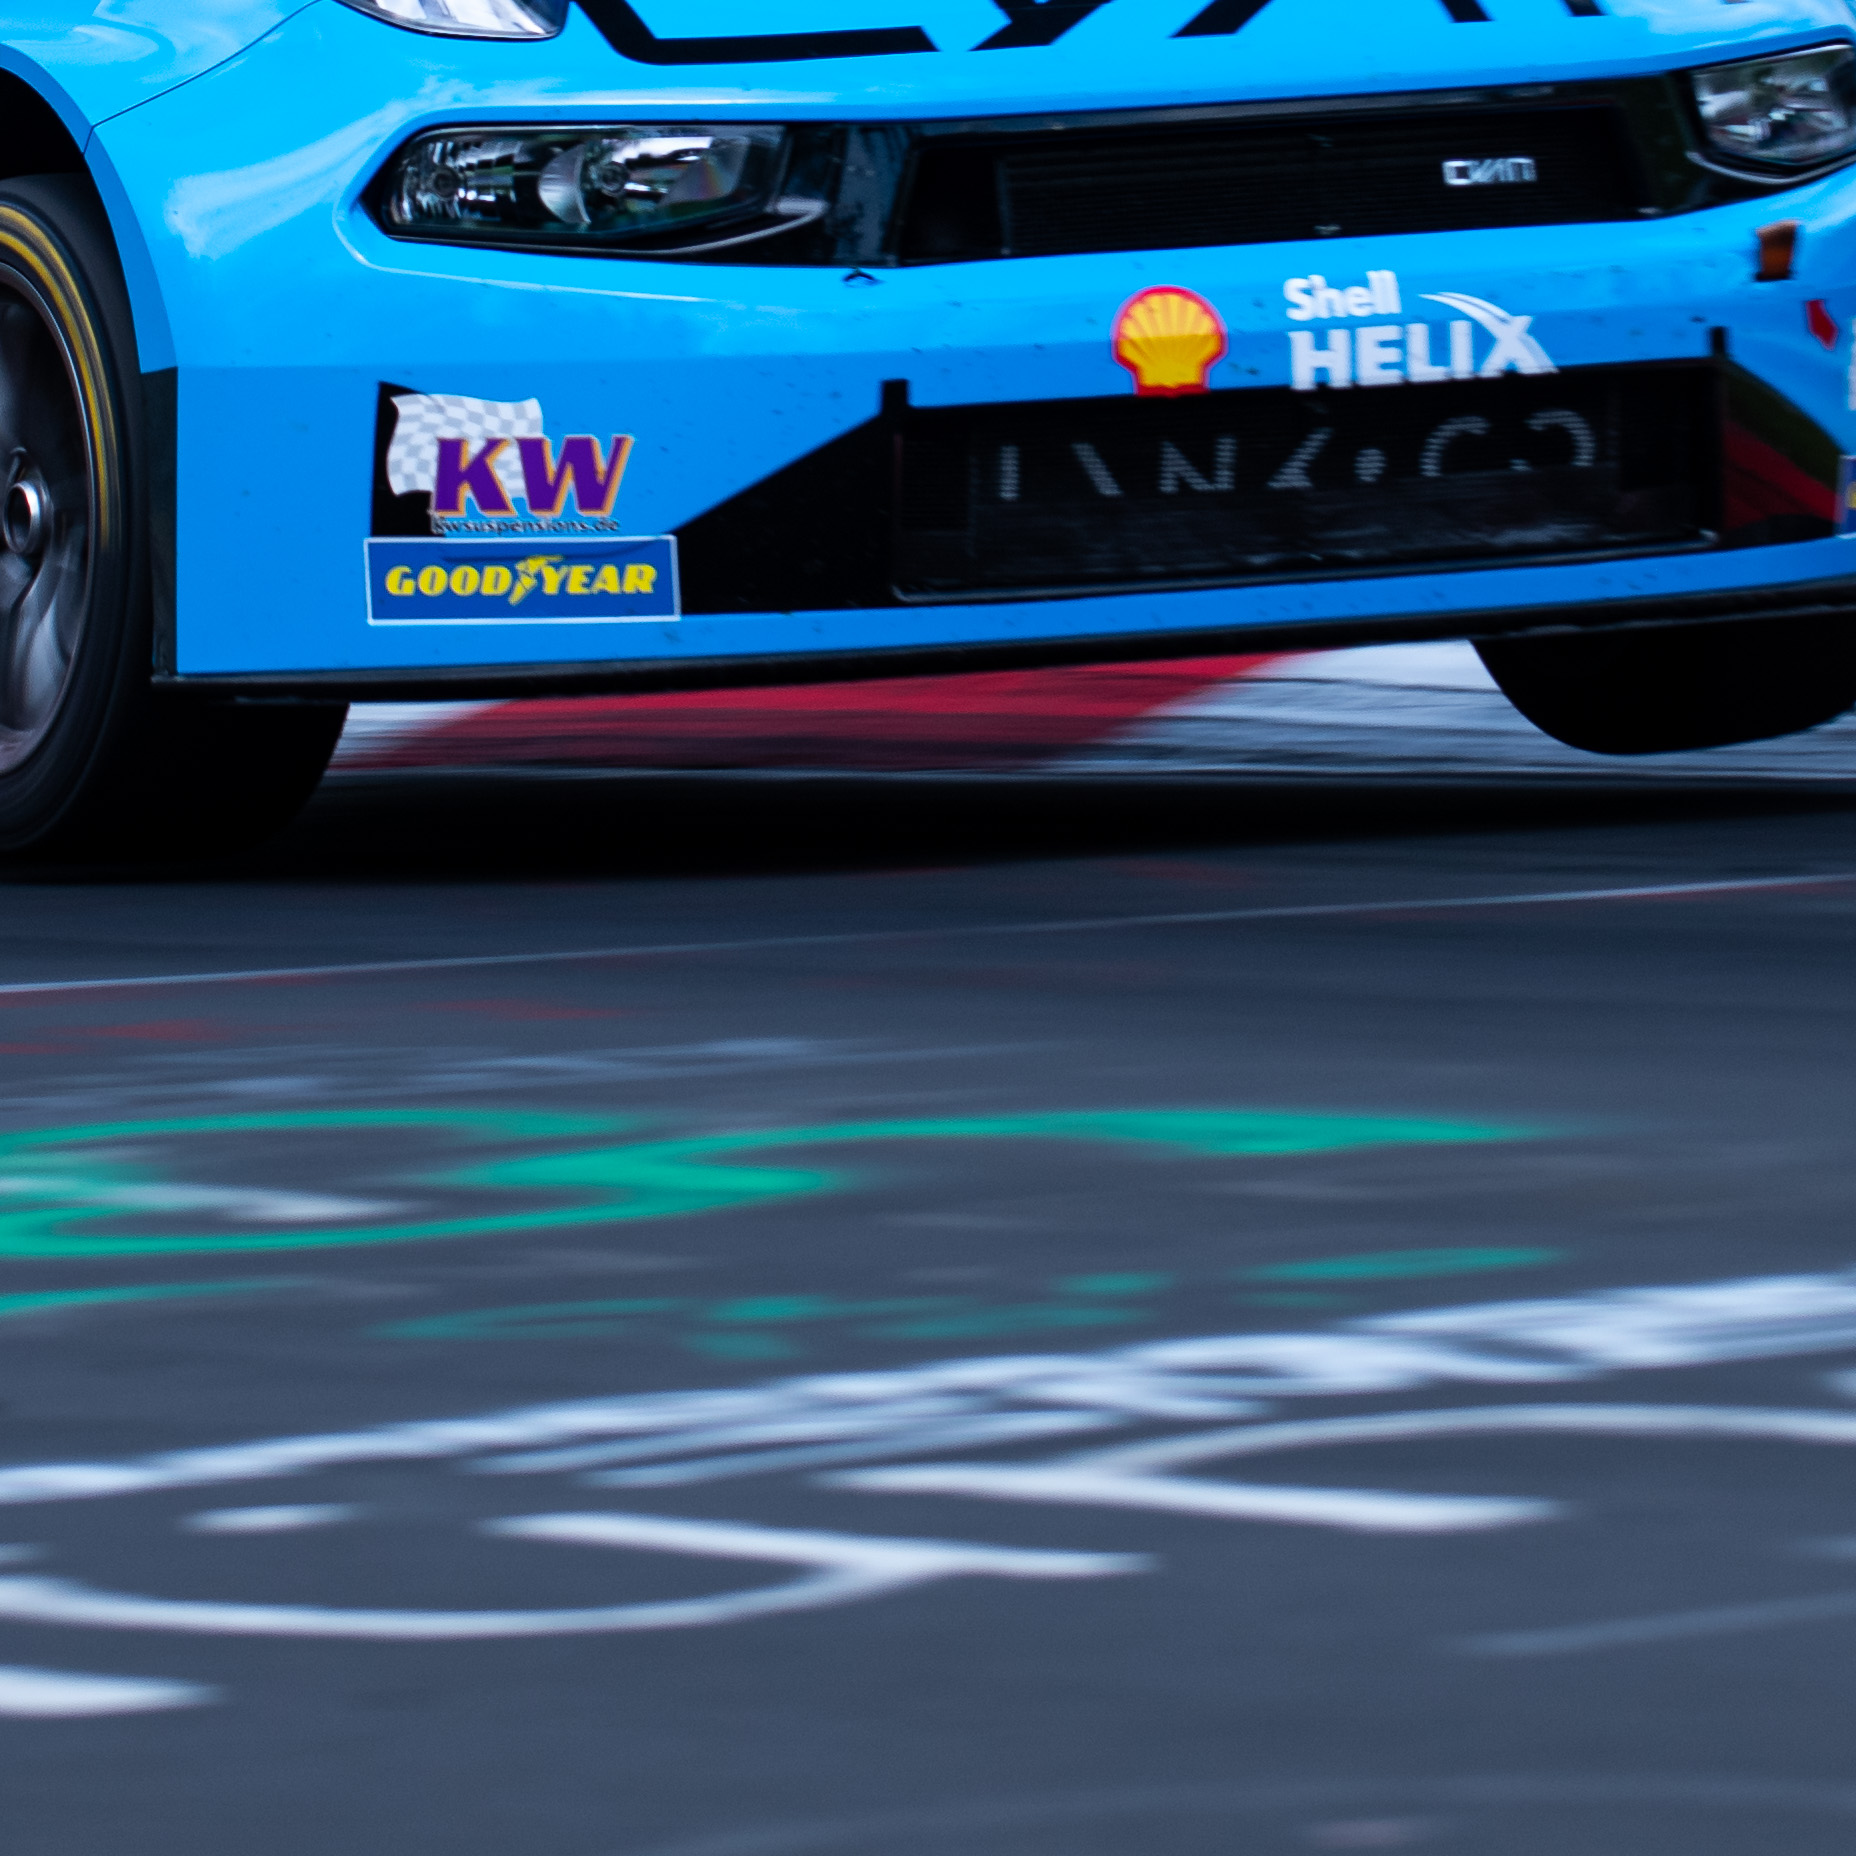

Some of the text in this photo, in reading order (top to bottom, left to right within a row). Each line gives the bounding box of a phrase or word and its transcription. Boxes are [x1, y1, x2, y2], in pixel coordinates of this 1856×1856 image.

[1283, 270, 1402, 322] Shell
[1287, 312, 1560, 391] HELIX
[430, 433, 635, 518] KW
[385, 555, 657, 606] GOODYEAR
